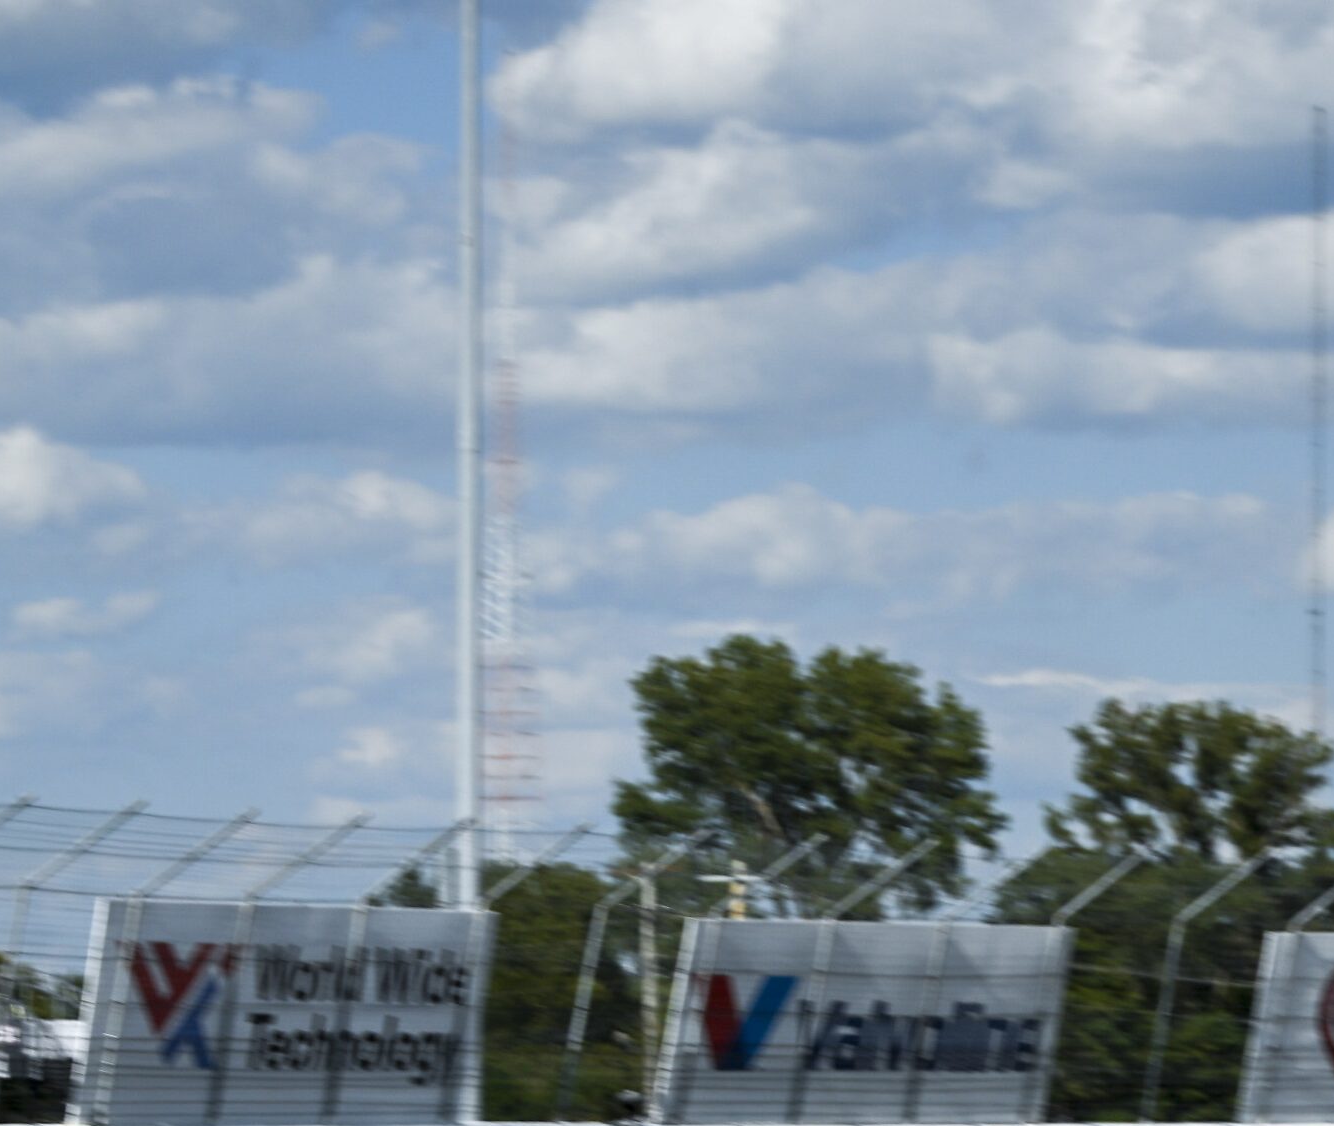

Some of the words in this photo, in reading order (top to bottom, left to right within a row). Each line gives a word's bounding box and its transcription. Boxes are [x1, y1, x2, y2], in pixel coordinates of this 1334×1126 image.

[253, 944, 369, 1002] World
[373, 946, 470, 1006] Wide
[245, 1013, 461, 1087] Technology
[796, 1000, 1043, 1072] Valvoline
